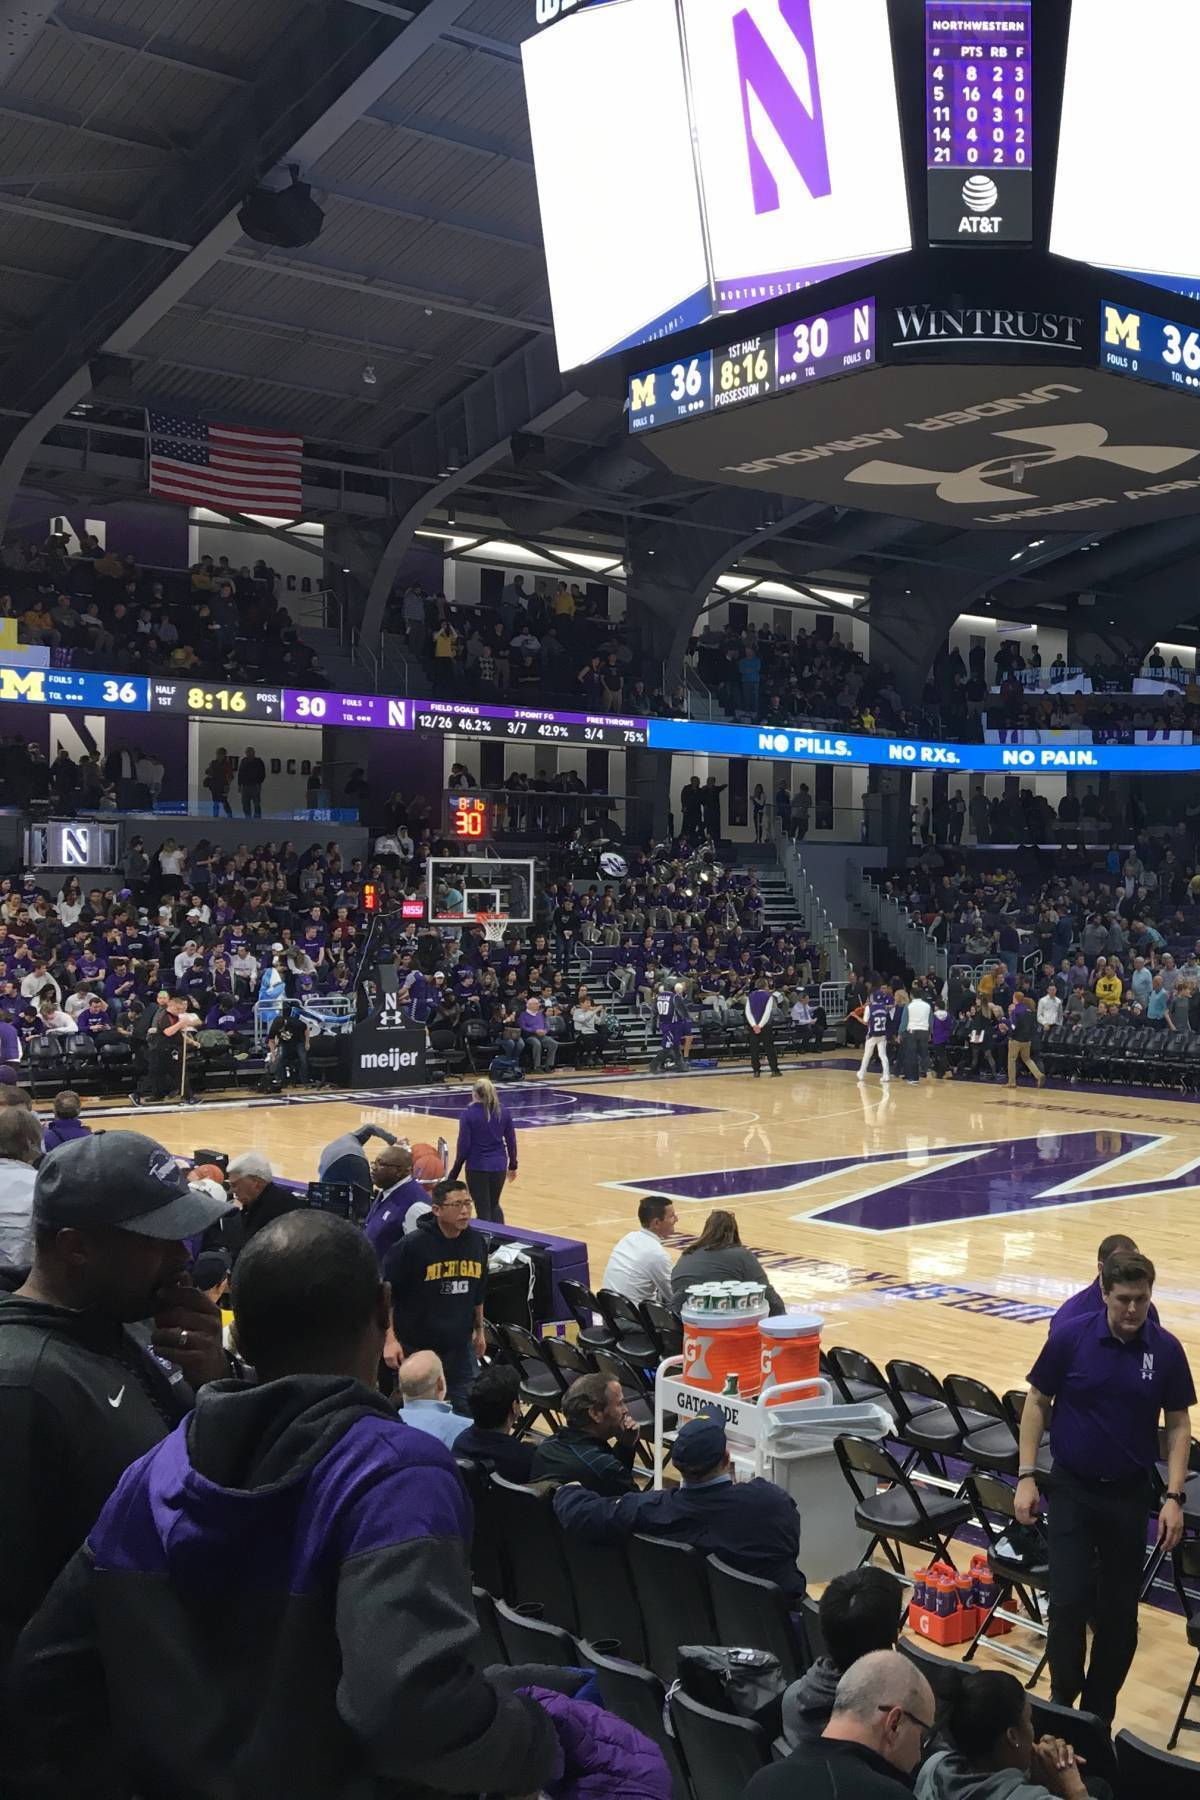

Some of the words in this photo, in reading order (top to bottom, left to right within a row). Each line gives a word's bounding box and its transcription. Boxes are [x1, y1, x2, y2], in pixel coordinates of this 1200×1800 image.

[933, 20, 1024, 31] NORTHWESTERN
[961, 47, 983, 57] PTS
[990, 47, 1007, 57] RB
[1016, 47, 1024, 57] F
[933, 66, 944, 80] 4
[966, 66, 977, 81] 8
[993, 67, 1003, 81] 2
[1015, 67, 1024, 81] 3
[934, 87, 944, 101] 5
[963, 87, 980, 101] 16
[992, 87, 1003, 101] 4
[1015, 88, 1024, 102] 0
[732, 0, 832, 215] N
[933, 107, 950, 121] 11
[967, 107, 977, 121] 0
[993, 108, 1003, 122] 3
[1015, 108, 1023, 122] 1
[933, 127, 951, 141] 14
[966, 128, 977, 142] 4
[993, 128, 1004, 142] 0
[1015, 128, 1024, 142] 2
[934, 148, 950, 162] 21
[967, 148, 978, 162] 0
[993, 148, 1003, 162] 2
[1016, 149, 1024, 163] 0
[958, 217, 1002, 233] AT&T
[854, 305, 869, 344] N
[894, 304, 1084, 342] WINTRUST
[1105, 306, 1141, 351] M
[728, 343, 741, 358] 1ST
[742, 337, 760, 355] HALF
[793, 318, 828, 363] 30
[843, 354, 861, 367] FOULS
[1106, 353, 1128, 368] FOULS
[1132, 360, 1138, 371] 0
[721, 350, 768, 390] 8:16
[1171, 371, 1183, 383] TOL
[670, 359, 701, 401] 36
[631, 374, 656, 411] M
[714, 383, 759, 407] POSSESSION
[905, 383, 1083, 433] UNDER
[633, 416, 648, 428] FOULS
[722, 429, 905, 474] ARMOUR
[976, 496, 1118, 523] UNDER
[0, 669, 46, 701] M
[49, 675, 72, 685] FOULS
[103, 681, 137, 703] 36
[155, 685, 176, 695] HALF
[256, 693, 279, 704] POSS.
[158, 697, 172, 706] 1ST
[187, 688, 247, 712] 8:16
[296, 696, 326, 717] 30
[342, 698, 362, 708] FOULS
[430, 703, 453, 713] FIELD
[455, 705, 479, 715] GOALS
[388, 700, 405, 726] N
[514, 710, 519, 718] 3
[520, 711, 542, 719] POINT
[544, 712, 554, 721] FG
[586, 717, 604, 725] FREE
[605, 718, 634, 727] THROWS
[418, 714, 452, 730] 12/26
[458, 718, 491, 732] 46.2%
[507, 722, 527, 735] 3/7
[538, 724, 569, 737] 42.9%
[584, 727, 603, 741] 3/4
[623, 731, 644, 743] 75%
[758, 734, 788, 752] NO
[794, 738, 852, 757] PILLS.
[889, 744, 916, 760] NO
[920, 746, 961, 763] RXs.
[1002, 750, 1035, 766] NO
[1041, 751, 1098, 766] PAIN.
[459, 797, 485, 811] 8:16
[456, 812, 483, 835] 30
[62, 828, 89, 864] N
[385, 992, 397, 1010] N
[874, 1017, 887, 1031] 23
[360, 1048, 418, 1071] meijer
[685, 1339, 696, 1361] G
[761, 1350, 772, 1374] G
[1143, 1353, 1153, 1369] N
